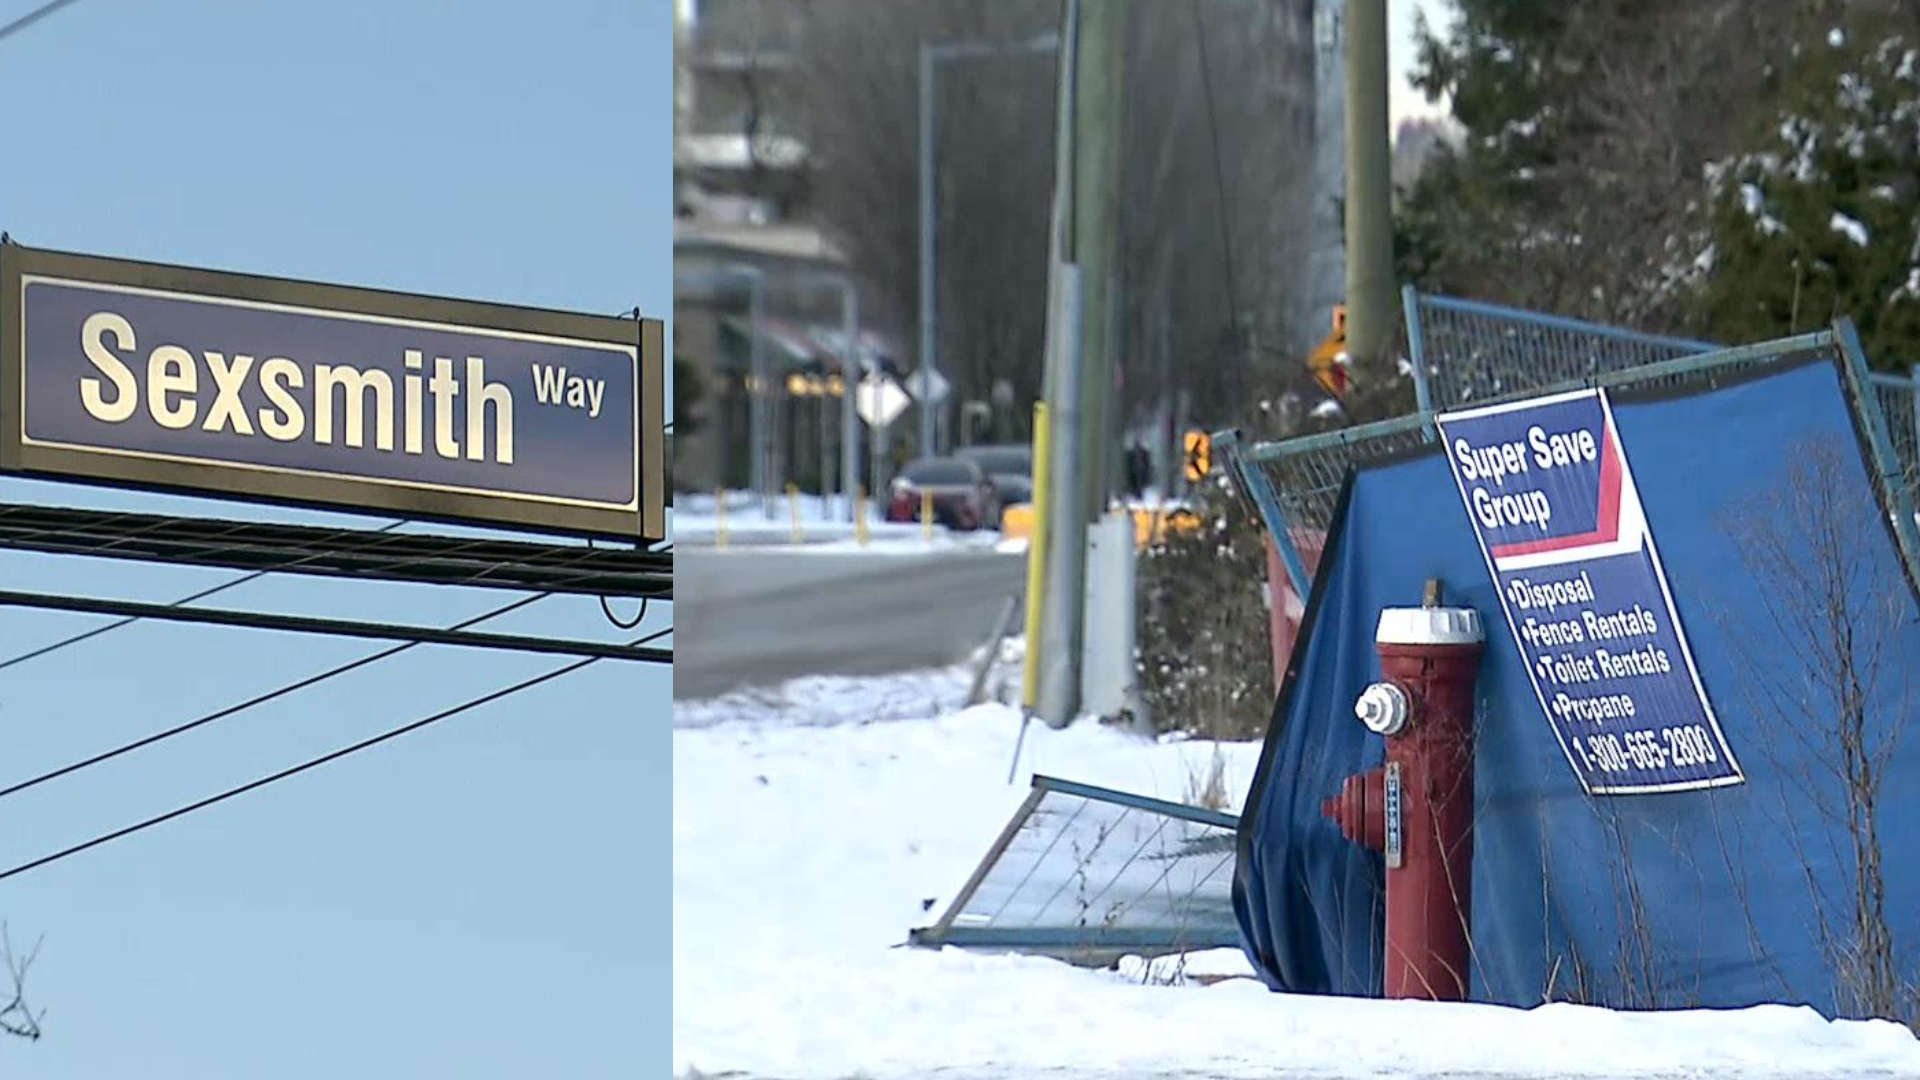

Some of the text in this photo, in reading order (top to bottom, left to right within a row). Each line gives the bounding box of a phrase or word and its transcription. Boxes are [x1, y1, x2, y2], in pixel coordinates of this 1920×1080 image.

[79, 311, 606, 465] Sexsmith Way
[1454, 424, 1598, 486] Super Save
[1472, 486, 1551, 531] Group
[1581, 604, 1658, 641] Rentals
[1595, 643, 1671, 679] Rentals
[1572, 724, 1718, 773] 1-800-665-2800
